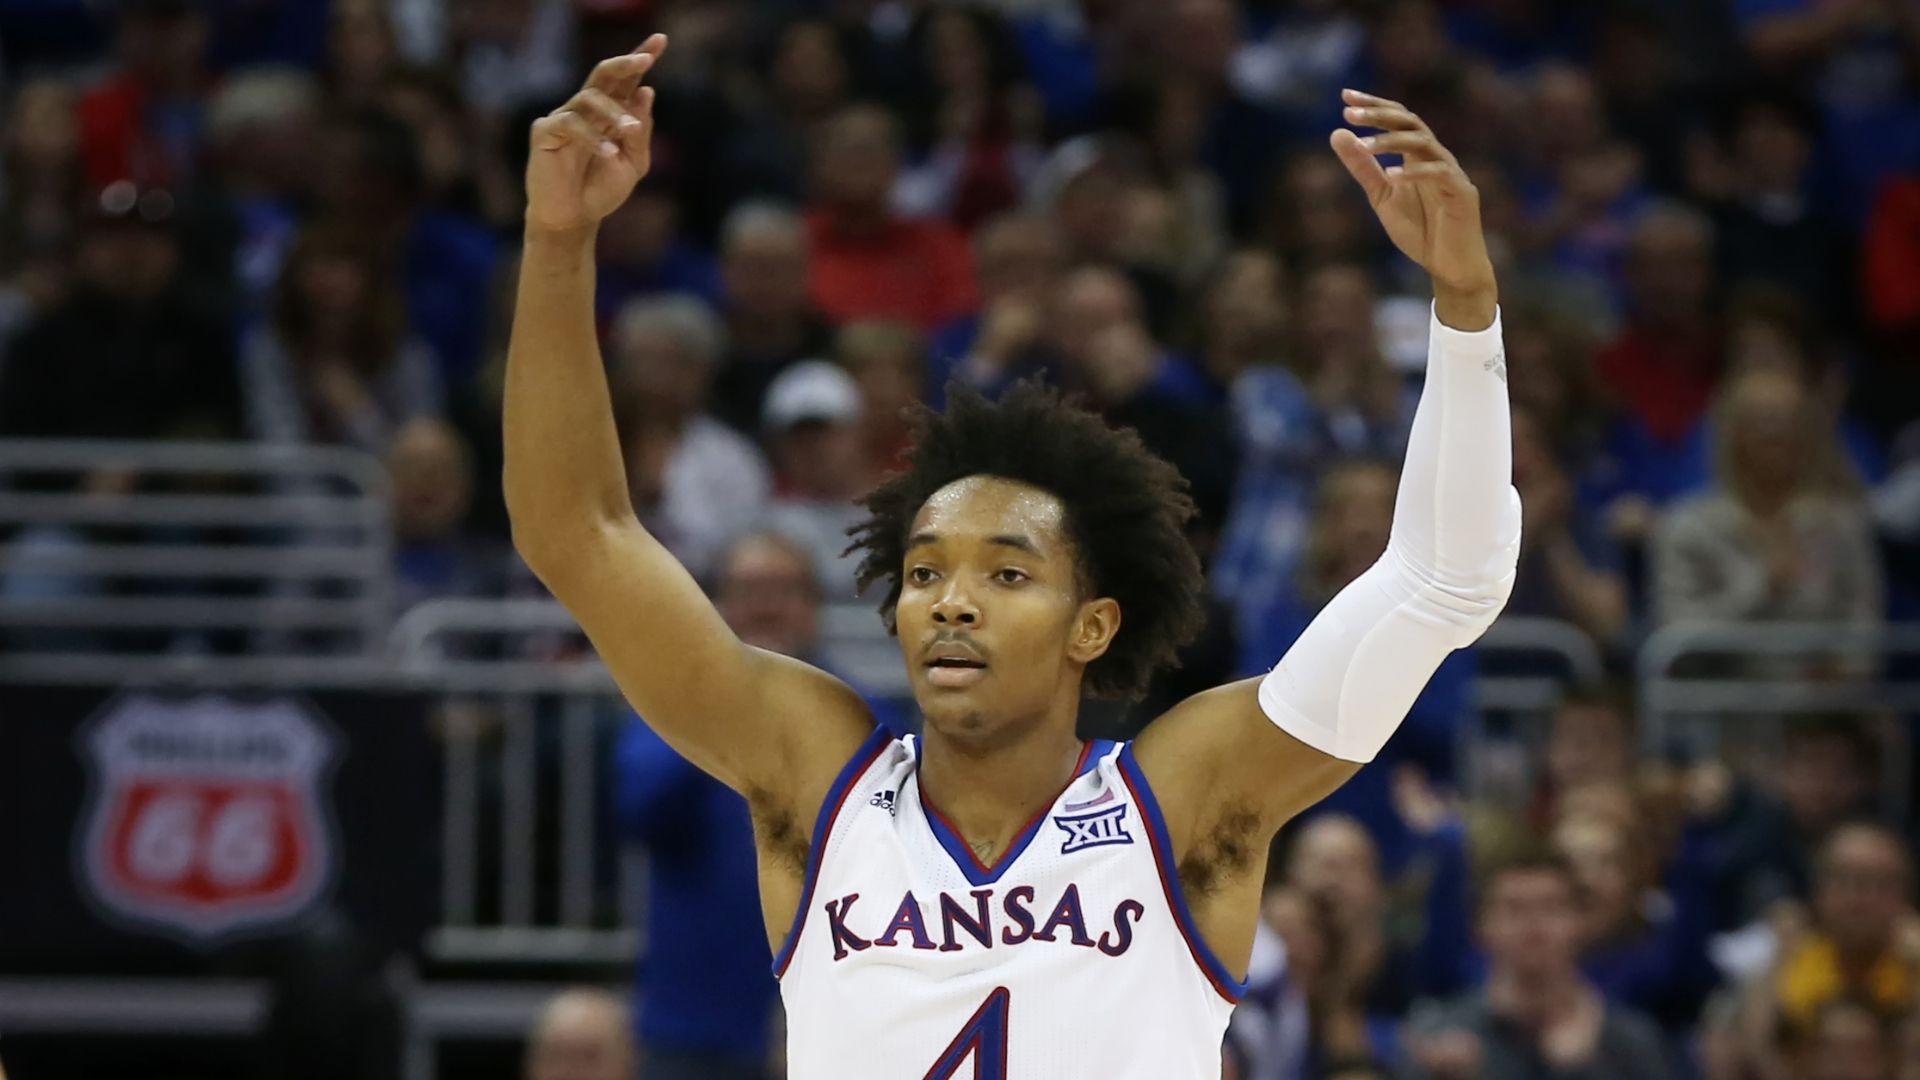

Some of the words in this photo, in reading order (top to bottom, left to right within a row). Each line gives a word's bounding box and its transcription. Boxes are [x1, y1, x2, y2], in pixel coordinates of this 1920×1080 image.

[128, 796, 274, 884] 66
[1055, 805, 1132, 853] XII
[825, 883, 1144, 961] KANSAS
